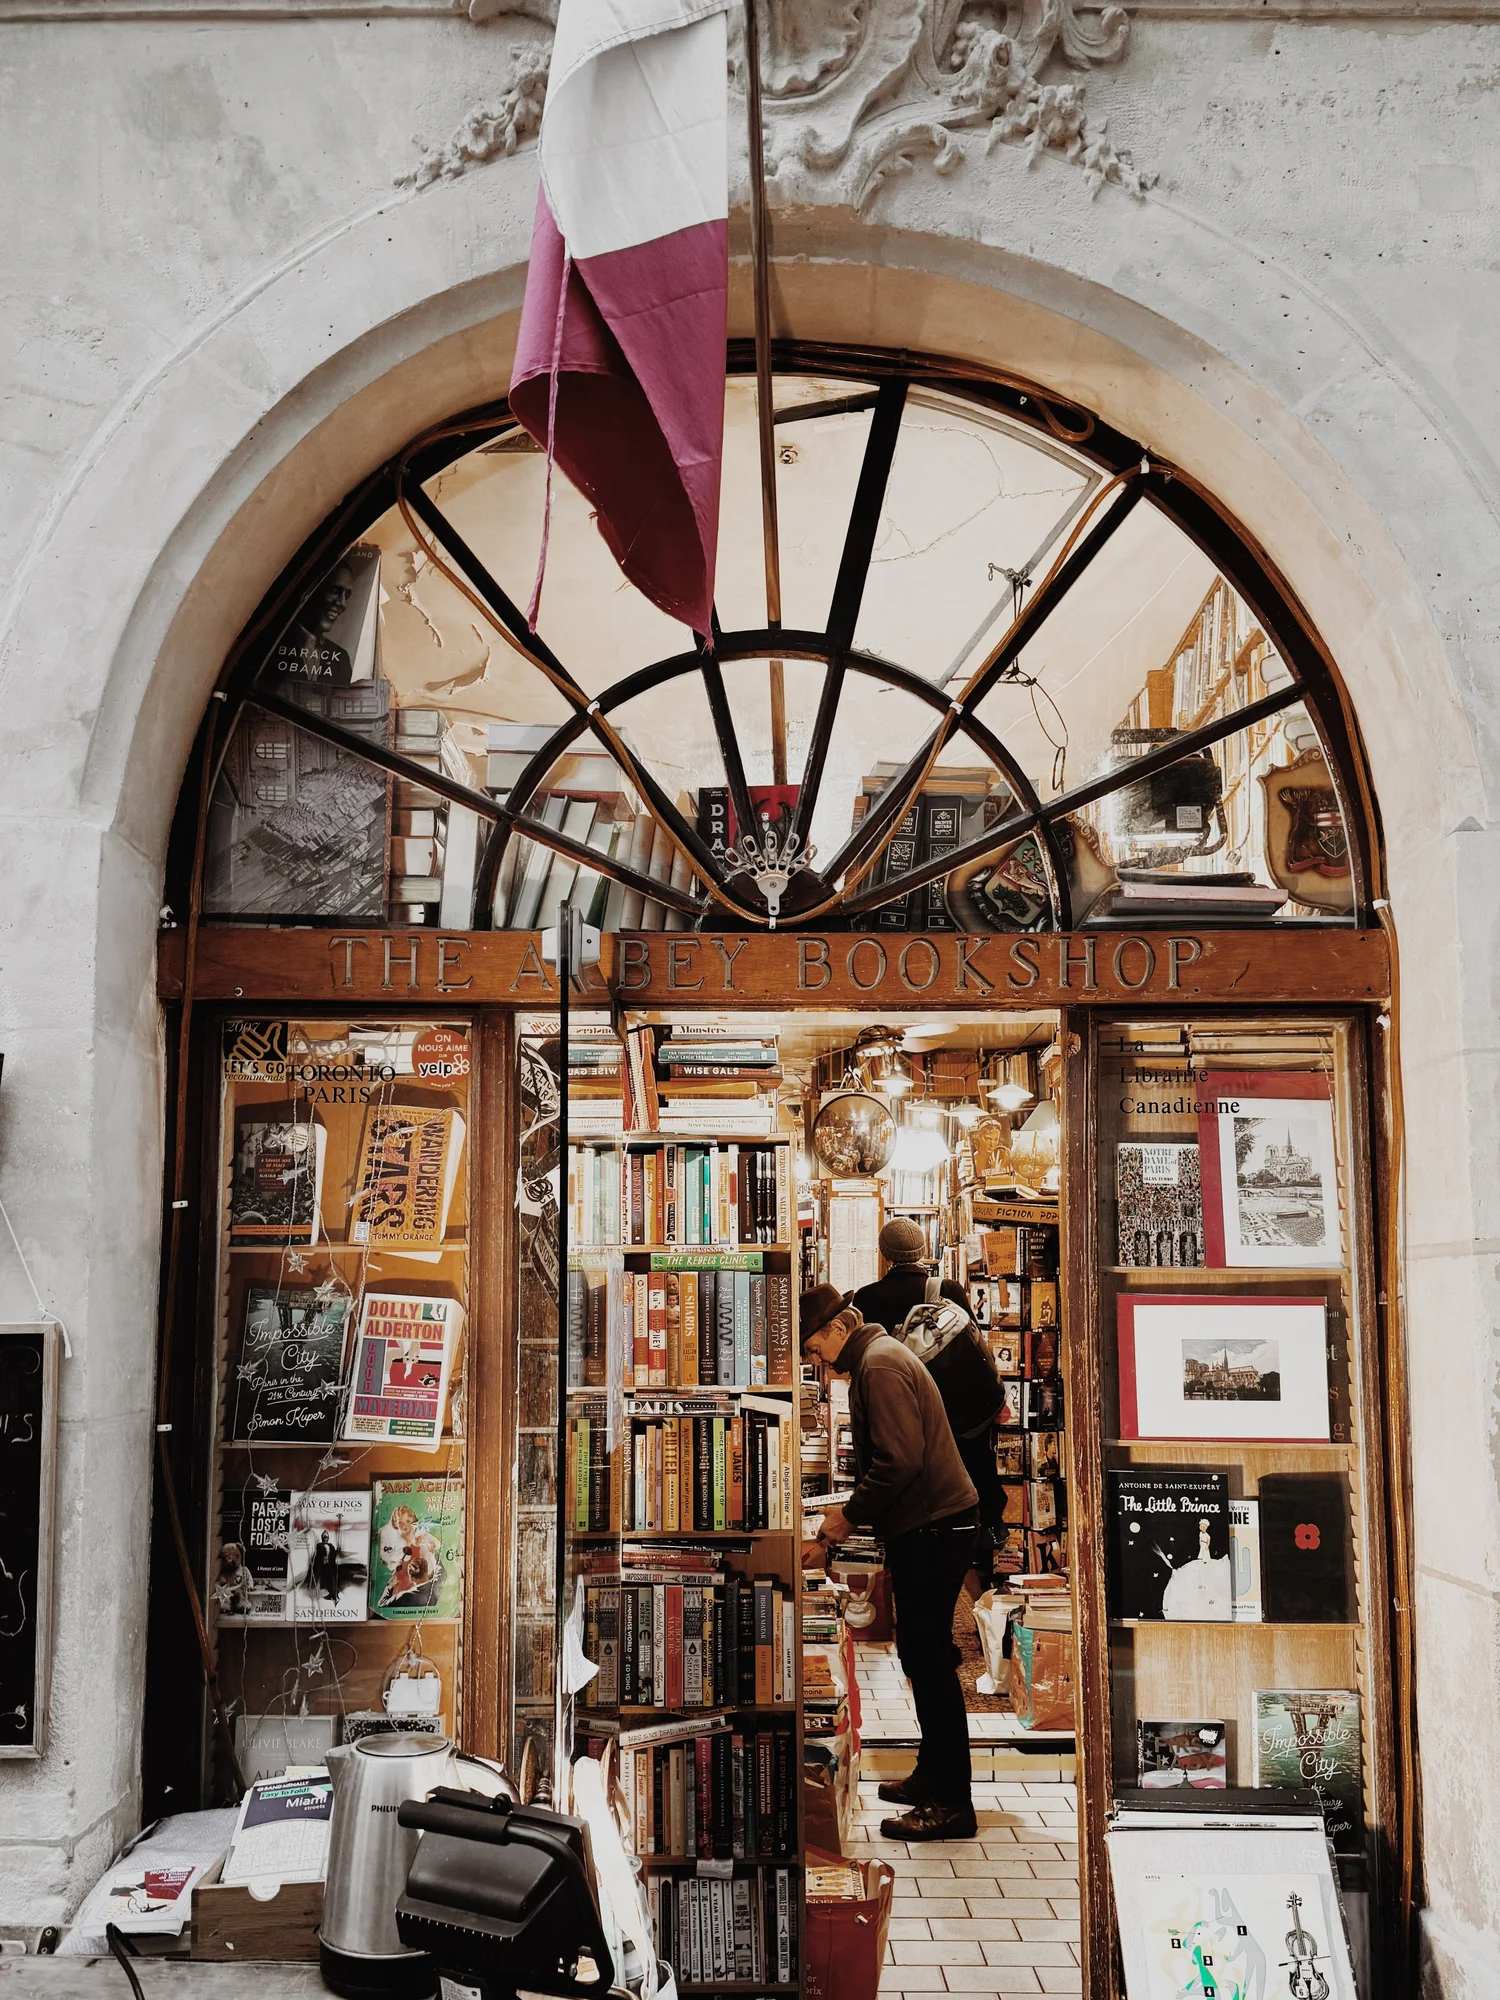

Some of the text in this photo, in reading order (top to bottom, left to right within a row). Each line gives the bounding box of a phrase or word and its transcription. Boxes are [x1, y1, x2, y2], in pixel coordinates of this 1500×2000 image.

[278, 646, 341, 661] BARACK
[278, 661, 333, 677] OBAMA
[711, 803, 726, 860] DRA
[329, 936, 1202, 993] THE ABEY BOOKSHOP
[680, 1025, 727, 1034] Monsters
[434, 1034, 451, 1043] ON
[1118, 1036, 1145, 1053] La
[418, 1044, 468, 1052] NOUS AIME
[224, 1060, 285, 1074] LET'S GO
[286, 1064, 396, 1082] TORONTO
[419, 1060, 453, 1077] yelp
[683, 1067, 739, 1075] WISE GALS
[1119, 1066, 1209, 1084] Librairie
[224, 1073, 285, 1081] recommends
[303, 1086, 371, 1103] PARIS
[1119, 1097, 1240, 1114] Canadienne
[1144, 1148, 1174, 1156] NOTRE
[1144, 1156, 1170, 1165] DAME
[412, 1122, 444, 1230] WANDERING
[1144, 1165, 1171, 1174] PARIS
[996, 1208, 1059, 1220] FICTION POP
[402, 1233, 434, 1241] ORANGE
[665, 1255, 748, 1265] THE REBEL'S CLINIC
[753, 1280, 761, 1305] Stephen
[779, 1277, 788, 1308] SARAH
[368, 1301, 419, 1320] DOLLY
[684, 1295, 695, 1337] SHARDS
[770, 1277, 779, 1345] CRESCENT CITY
[246, 1317, 337, 1346] Impossible
[365, 1320, 443, 1340] ALDERTON
[753, 1320, 763, 1351] Odyssey
[780, 1318, 788, 1346] MAAS
[281, 1343, 319, 1372] City
[363, 1339, 378, 1394] GOOD
[251, 1378, 279, 1390] Paris
[356, 1399, 433, 1417] MATERIAL
[628, 1401, 685, 1415] PARIS
[247, 1407, 325, 1431] Simon Kuper
[623, 1426, 631, 1475] LOUIS XIV
[665, 1431, 677, 1475] BUTTER
[782, 1436, 790, 1464] Therapy
[732, 1451, 742, 1483] JAMES
[782, 1466, 790, 1491] Abigail
[416, 1482, 460, 1493] AGENT
[318, 1500, 363, 1508] OF KINGS
[1119, 1495, 1220, 1513] The Little Prince
[1229, 1512, 1249, 1524] INE
[624, 1573, 712, 1584] IMPOSSIBLE CITY SIMON KUPER
[627, 1594, 633, 1603] AN
[295, 1609, 359, 1618] SANDERSON
[655, 1592, 663, 1632] Impossible
[654, 1632, 664, 1649] City
[674, 1628, 682, 1655] BOOK
[761, 1651, 766, 1661] MY
[625, 1664, 630, 1672] ED
[287, 1738, 321, 1749] BLAKE
[780, 1740, 786, 1751] LA
[1155, 1737, 1213, 1753] FIRS
[1259, 1721, 1351, 1754] Impossible
[1156, 1753, 1216, 1771] LADY
[1300, 1751, 1339, 1780] City
[286, 1796, 327, 1808] Miami
[779, 1875, 788, 1969] IMPOSSIBLE CITY SIMON KUPER
